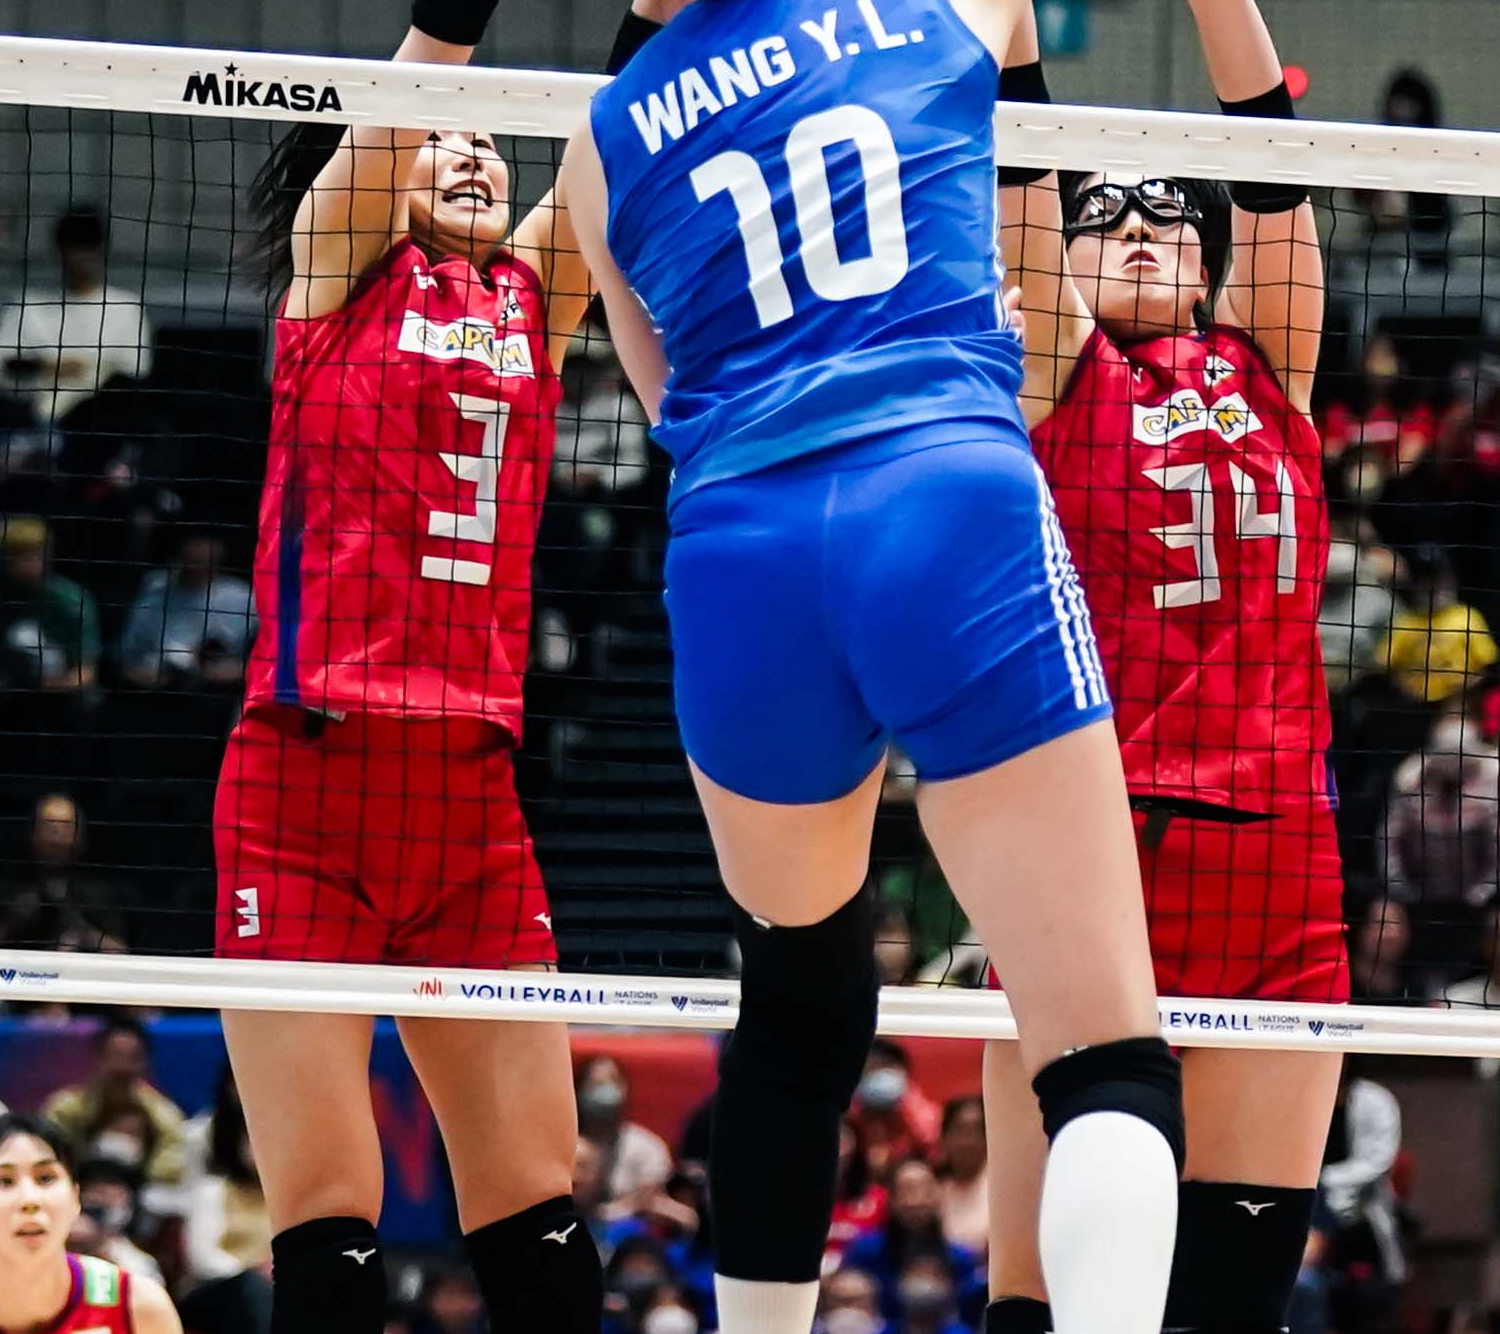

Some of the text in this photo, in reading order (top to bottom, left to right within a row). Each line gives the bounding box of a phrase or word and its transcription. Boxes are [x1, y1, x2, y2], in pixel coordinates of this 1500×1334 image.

[181, 71, 343, 113] MIKASA
[627, 35, 797, 156] WANG
[689, 103, 910, 329] 10
[428, 391, 511, 544] 3
[1141, 459, 1298, 610] 34
[460, 983, 610, 1005] VOLLEYBALL
[615, 990, 658, 1000] NATIONS
[1258, 1015, 1301, 1025] NATIONS
